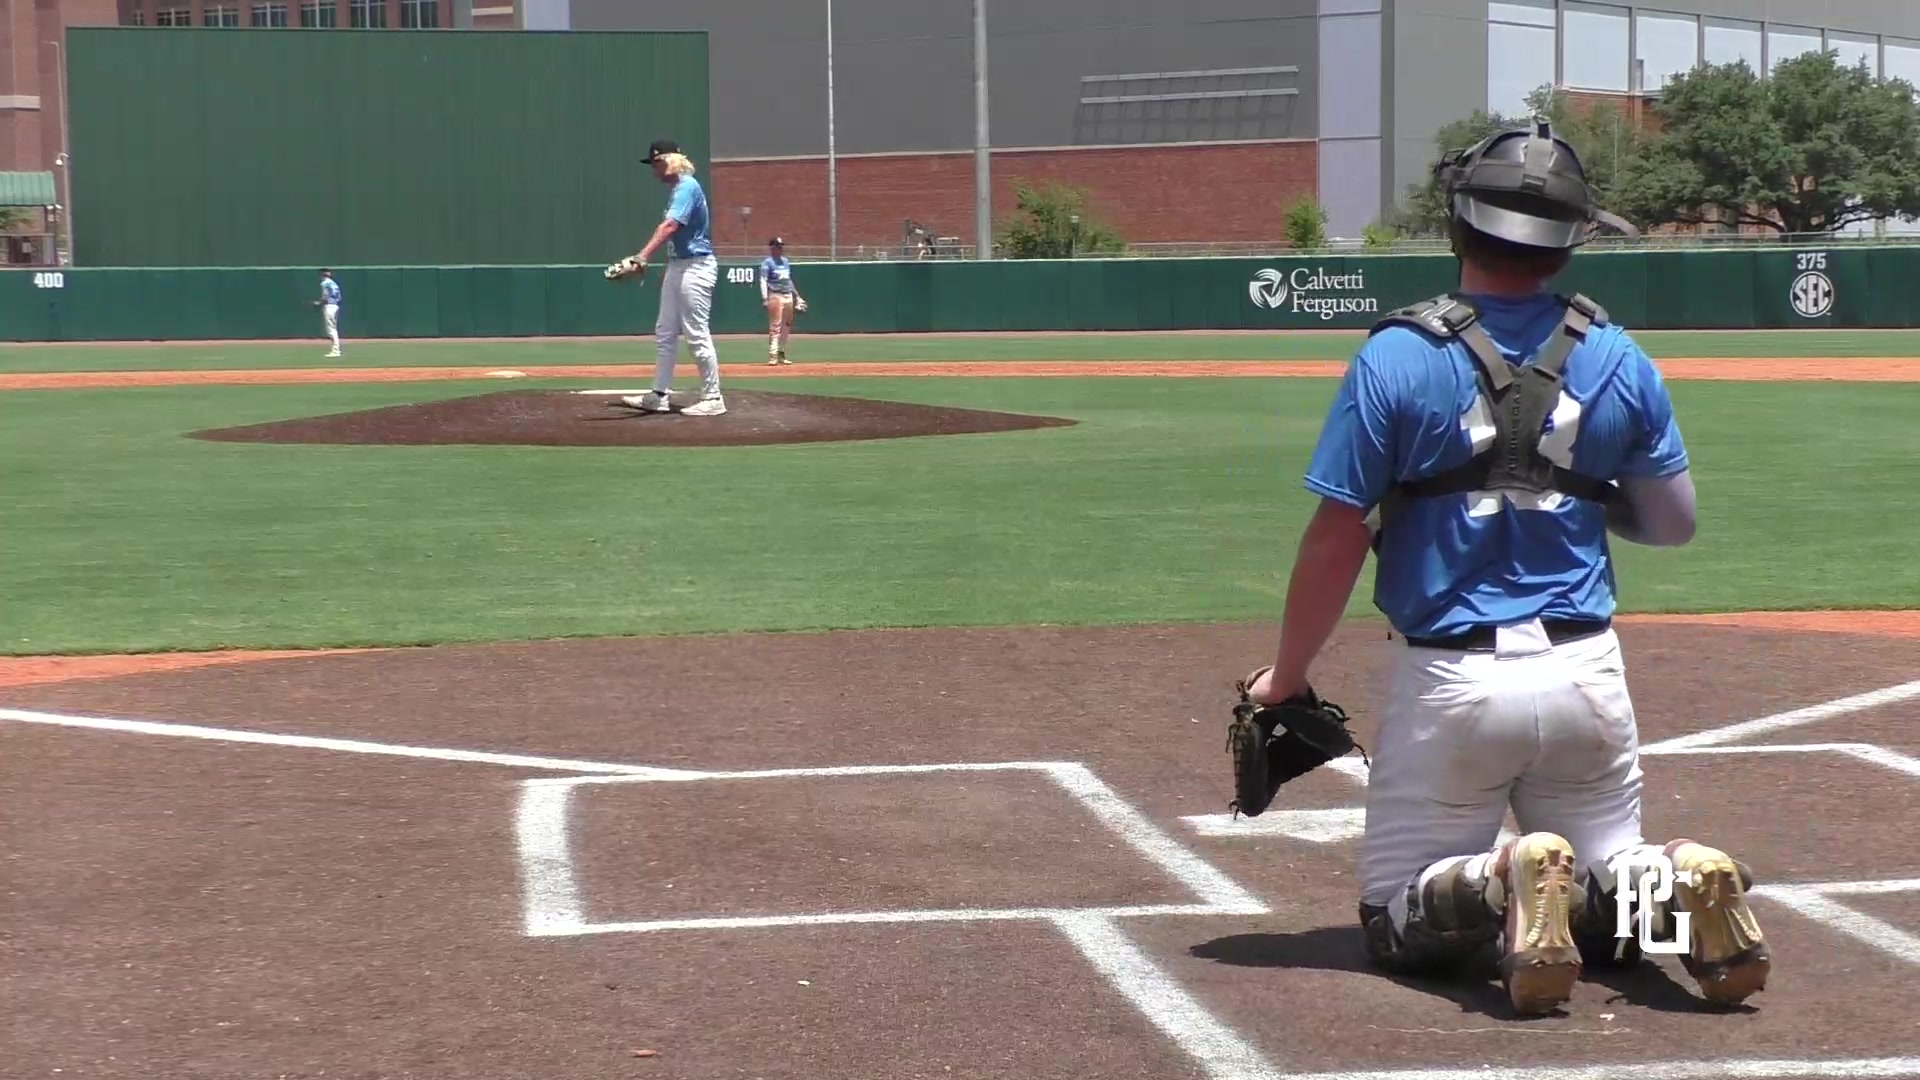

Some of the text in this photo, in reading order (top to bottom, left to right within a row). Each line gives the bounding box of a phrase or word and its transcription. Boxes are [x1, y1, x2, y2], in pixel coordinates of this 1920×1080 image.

[1797, 252, 1827, 270] 375
[34, 272, 64, 288] 400
[727, 267, 754, 283] 400
[1290, 267, 1364, 290] Calvetti
[1794, 275, 1830, 313] SEC
[1292, 291, 1378, 320] Ferguson
